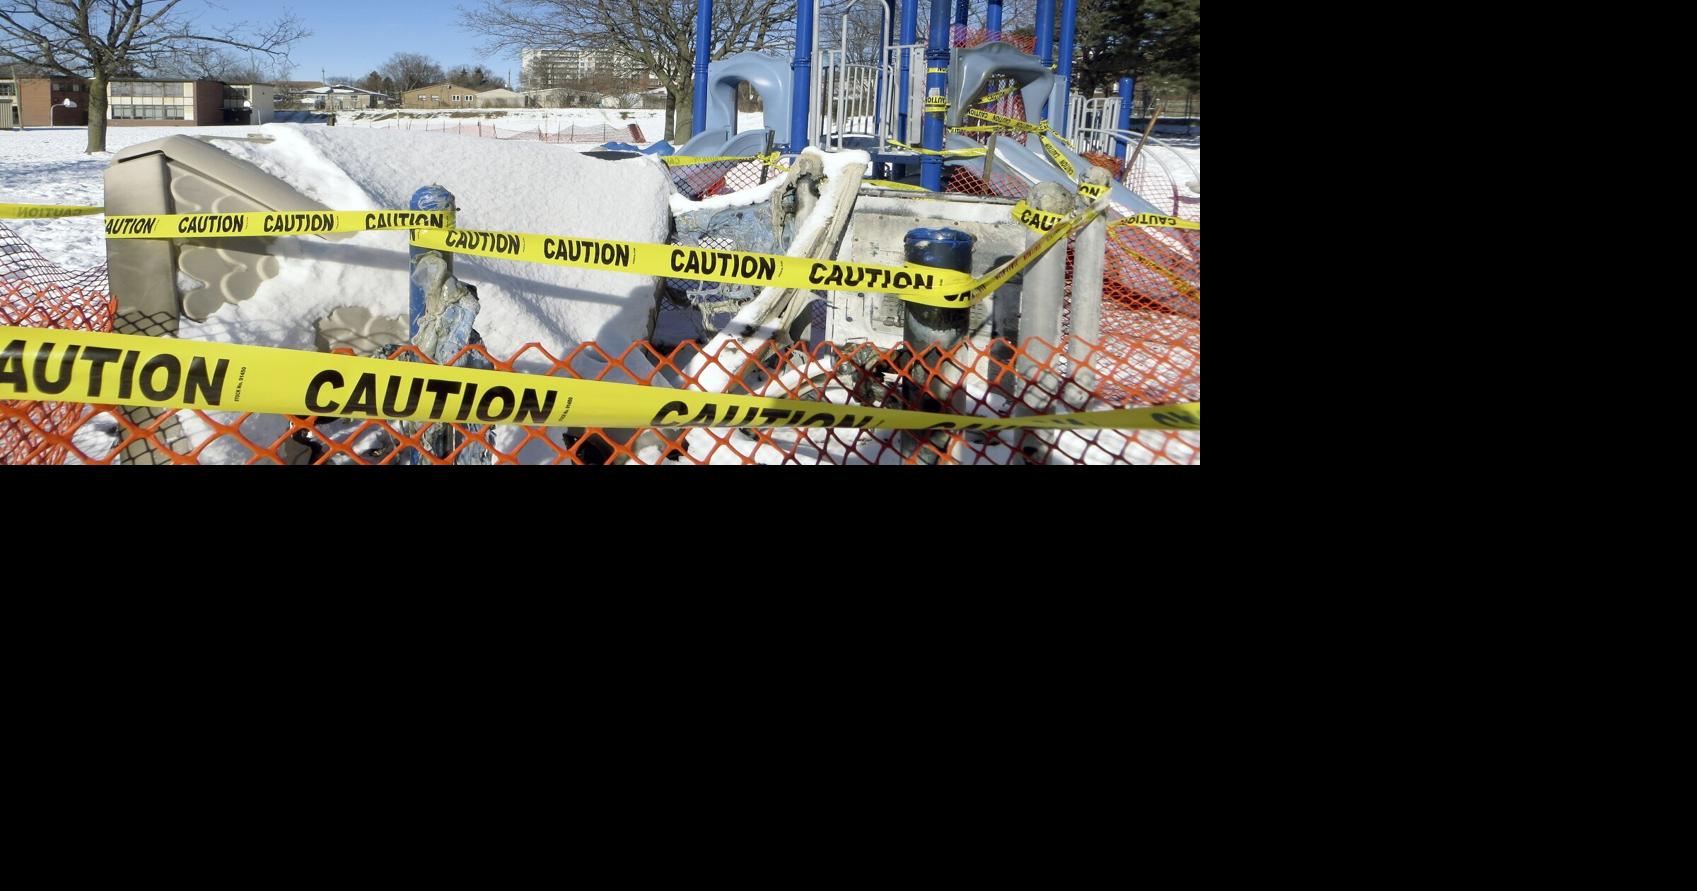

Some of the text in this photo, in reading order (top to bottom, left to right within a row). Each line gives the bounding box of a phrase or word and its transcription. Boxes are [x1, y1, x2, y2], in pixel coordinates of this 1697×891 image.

[105, 217, 156, 235] AUTION
[178, 215, 243, 233] CAUTION
[264, 214, 334, 232] CAUTION
[365, 213, 443, 230] CAUTION
[445, 230, 520, 254] CAUTION
[544, 238, 630, 267] CAUTION
[670, 249, 775, 280] CAUTION
[809, 263, 934, 289] CAUTION
[304, 369, 557, 423] CAUTION
